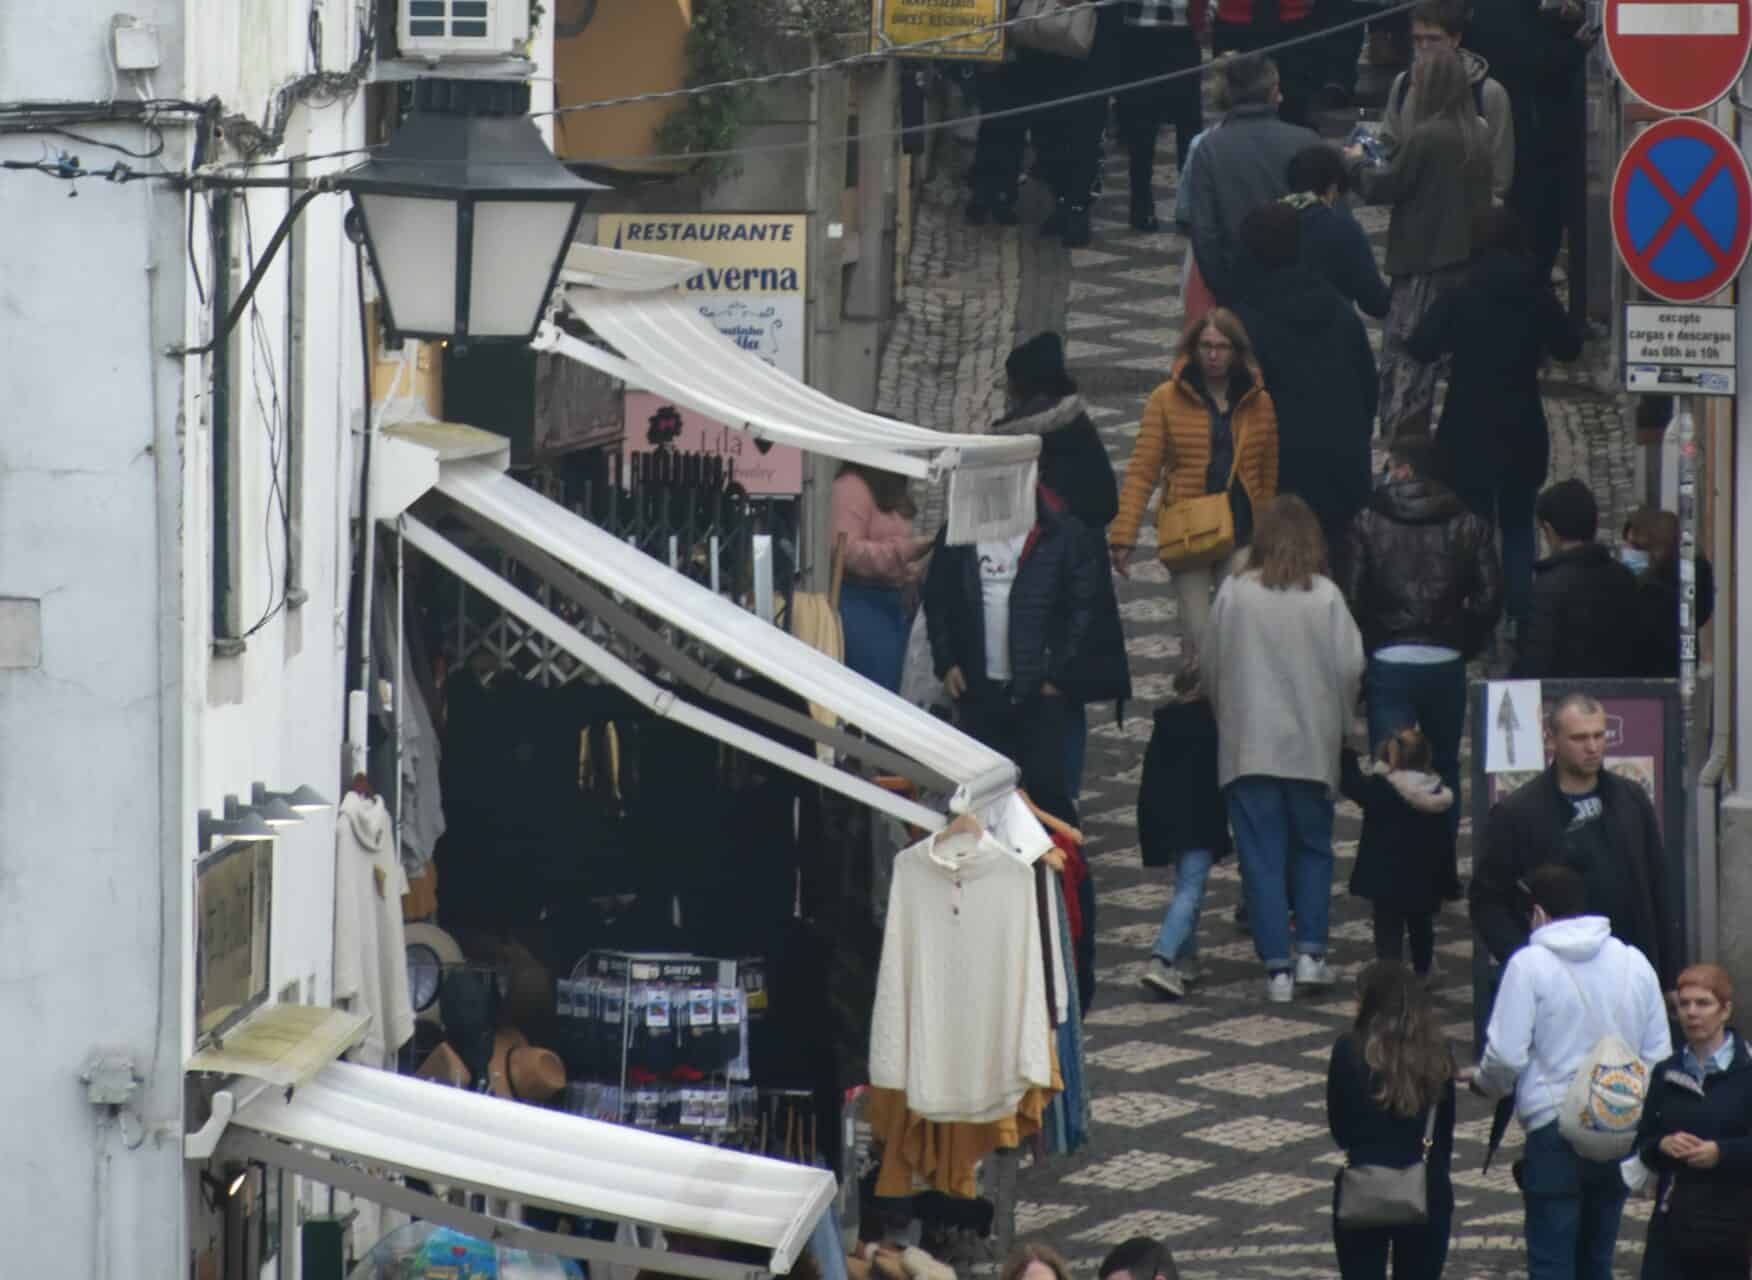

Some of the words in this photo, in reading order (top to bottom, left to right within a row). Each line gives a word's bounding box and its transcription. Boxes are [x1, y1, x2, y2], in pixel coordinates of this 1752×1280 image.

[627, 222, 794, 241] RESTAURANTE
[674, 266, 799, 291] averna
[1657, 312, 1702, 326] excepto
[1629, 330, 1665, 342] cargas
[1667, 331, 1674, 340] e
[1677, 328, 1731, 344] descargas
[1641, 346, 1659, 358] das
[1700, 346, 1720, 359] 10h
[702, 425, 743, 455] Lila
